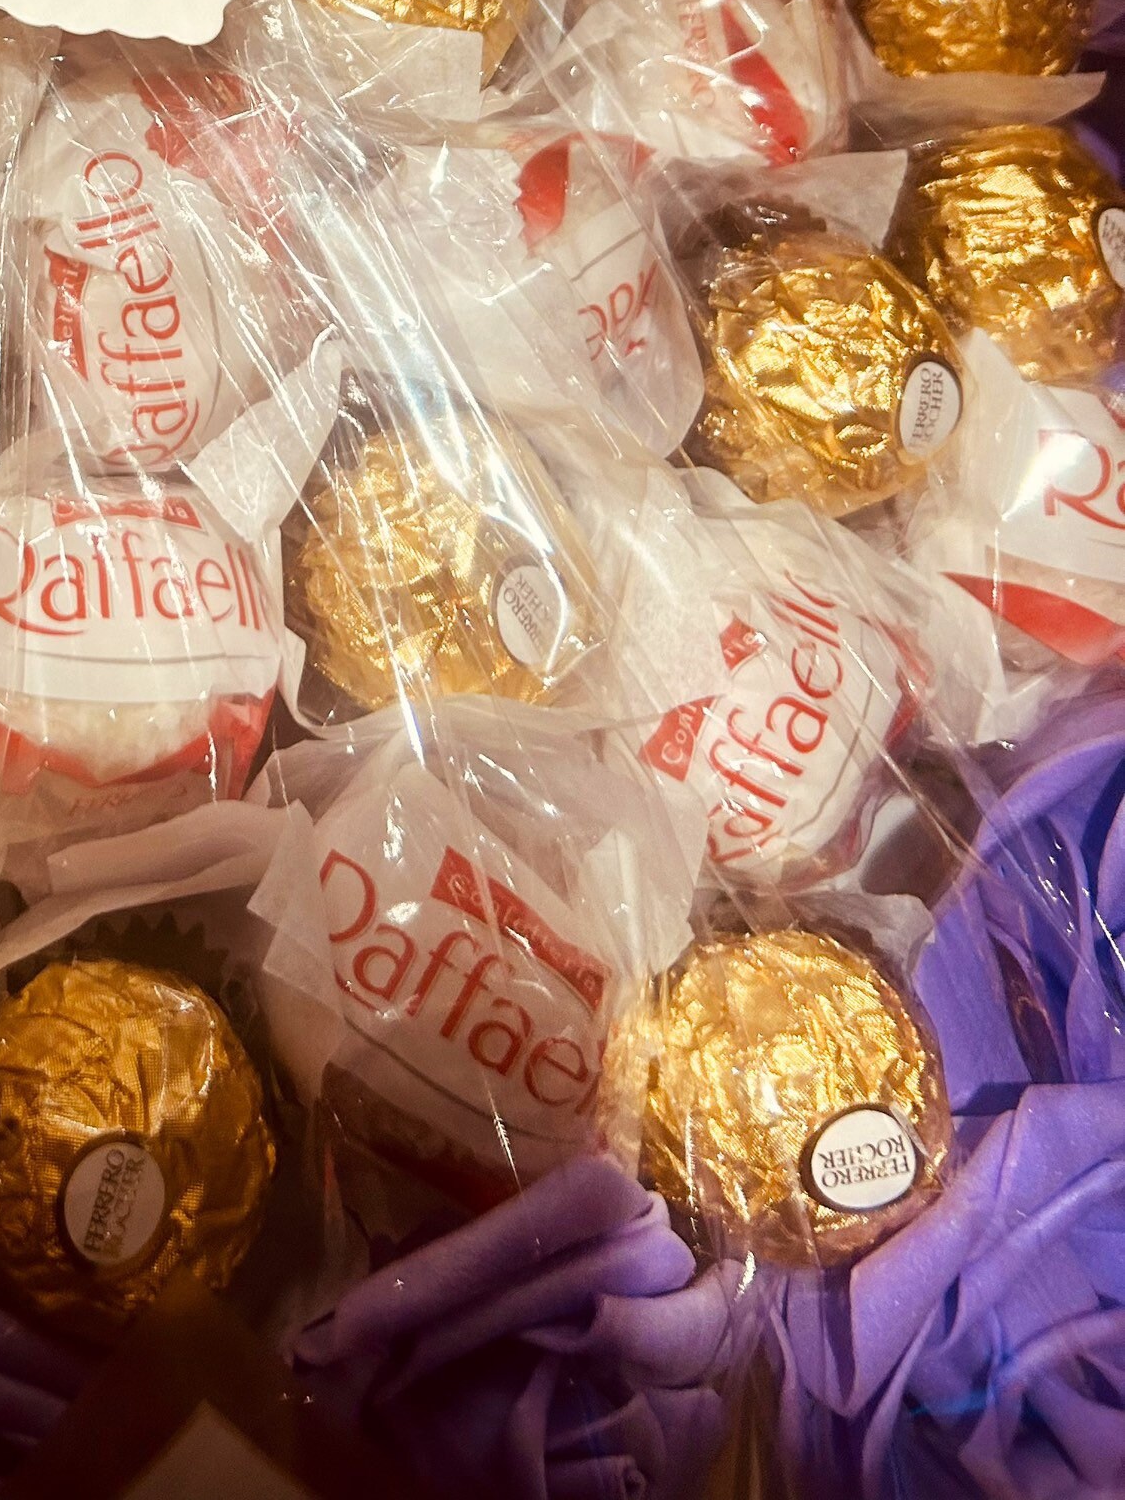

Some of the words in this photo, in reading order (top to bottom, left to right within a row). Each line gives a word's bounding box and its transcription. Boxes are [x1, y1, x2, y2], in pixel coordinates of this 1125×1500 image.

[921, 371, 944, 443] OCHER
[818, 1135, 906, 1169] ROCHER
[822, 1155, 910, 1188] FERRERO
